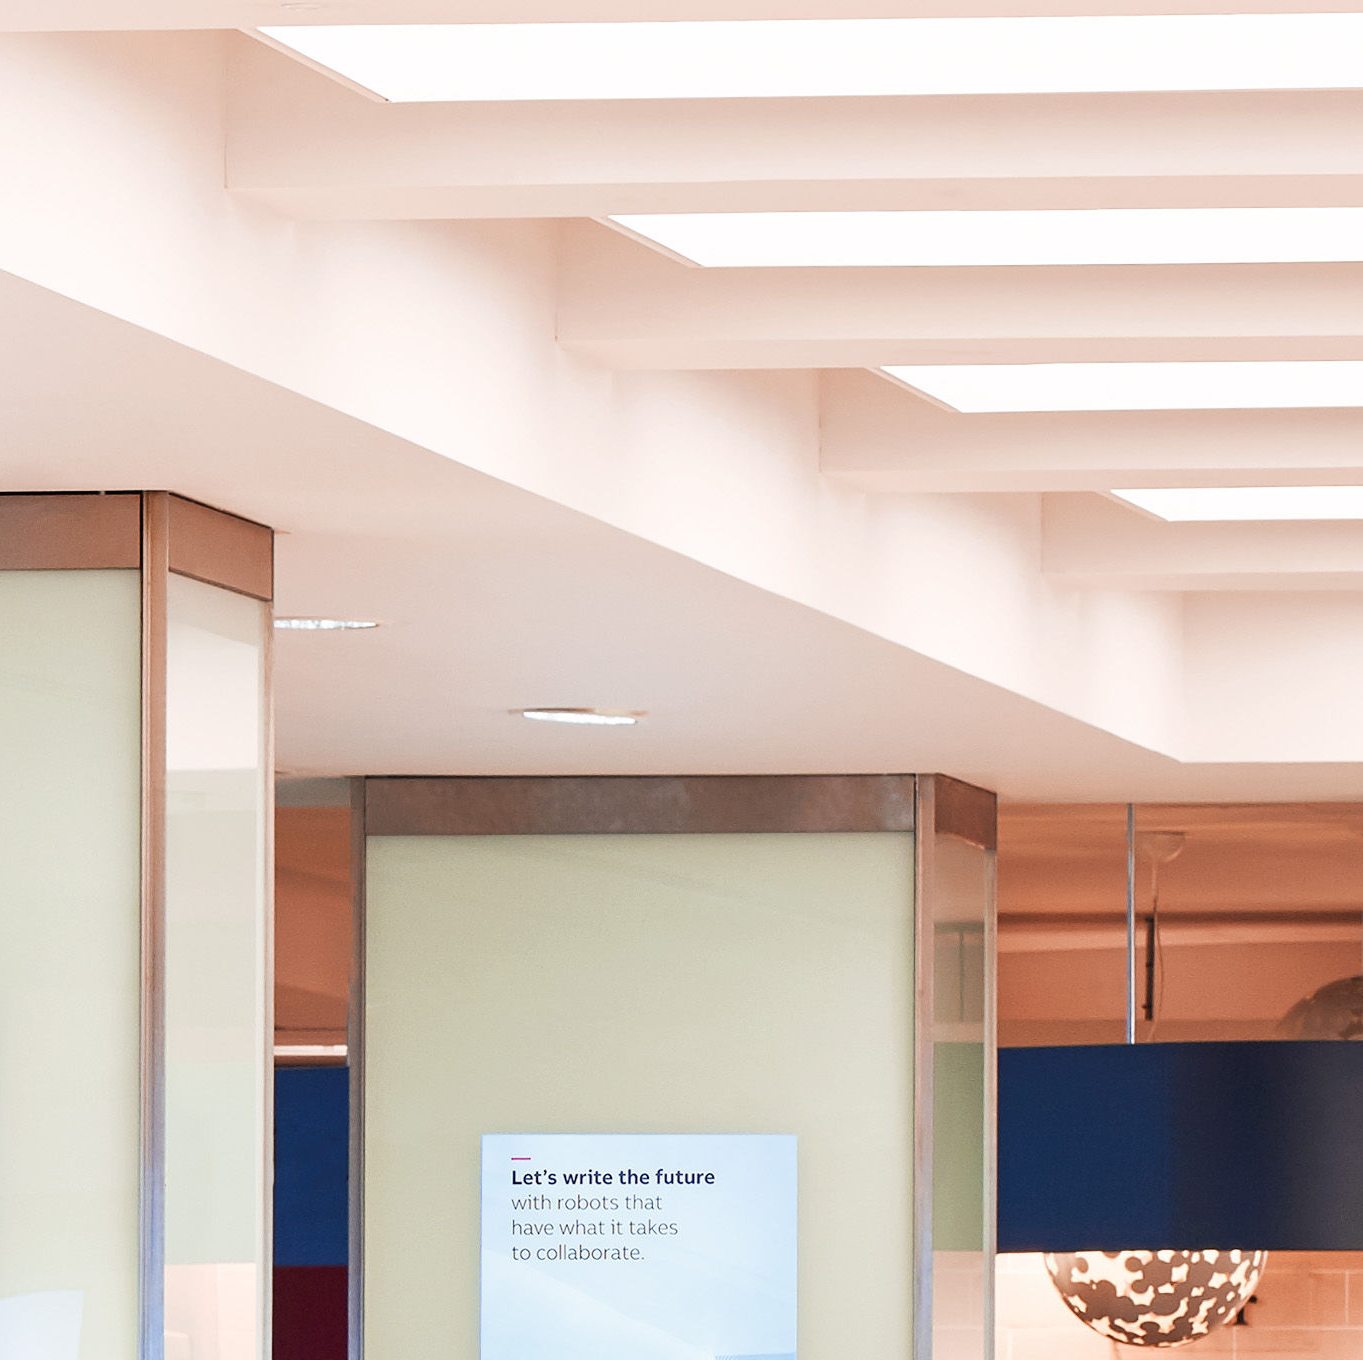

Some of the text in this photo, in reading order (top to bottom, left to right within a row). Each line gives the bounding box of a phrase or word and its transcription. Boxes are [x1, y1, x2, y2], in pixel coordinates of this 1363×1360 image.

[511, 1168, 715, 1186] Let’s write the future
[511, 1194, 663, 1210] with robots that
[511, 1219, 678, 1236] have what it takes
[512, 1244, 645, 1261] to collaborate.
